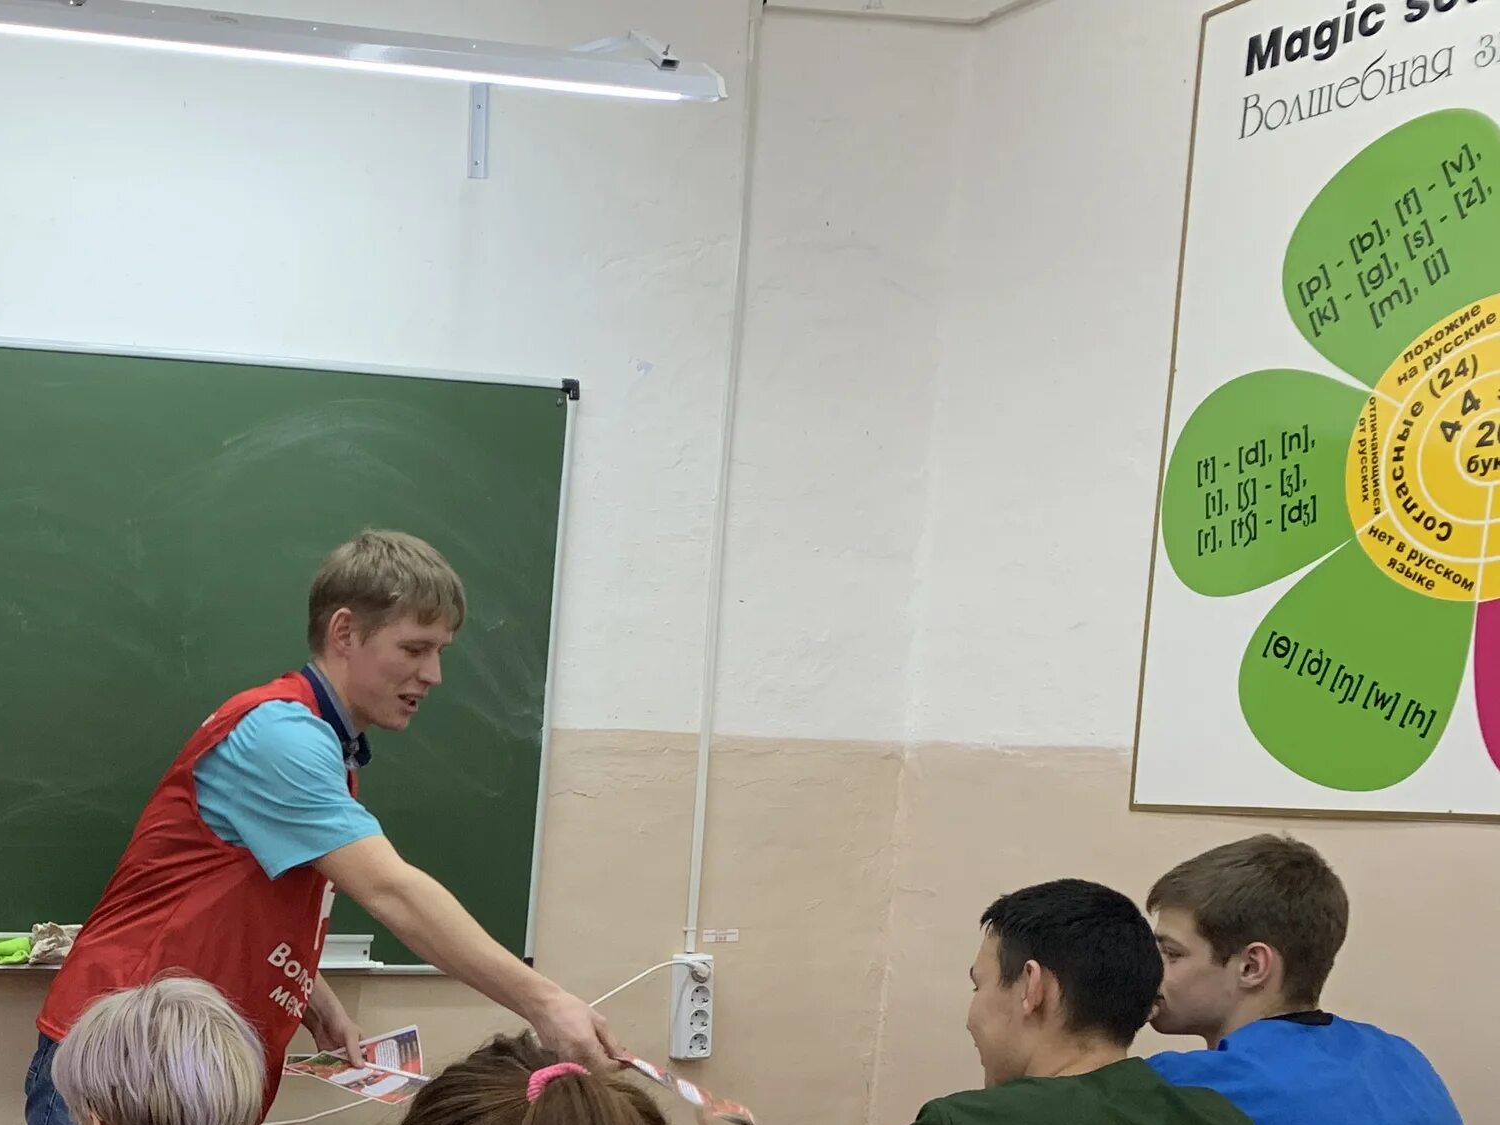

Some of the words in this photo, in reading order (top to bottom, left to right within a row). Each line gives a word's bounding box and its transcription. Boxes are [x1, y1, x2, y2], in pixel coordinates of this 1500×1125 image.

[1245, 1, 1386, 77] Magic
[1238, 46, 1456, 140] Волшебная
[1397, 367, 1419, 387] на
[1423, 311, 1497, 374] русские
[1403, 304, 1482, 364] похожие
[1359, 417, 1367, 436] от
[1369, 396, 1381, 516] отличающиеся
[1392, 399, 1453, 543] Согласные
[1428, 353, 1479, 399] (24)
[1359, 438, 1370, 503] русских
[1367, 525, 1395, 547] нет
[1395, 541, 1405, 553] в
[1406, 544, 1475, 593] русском
[1387, 556, 1436, 591] языке
